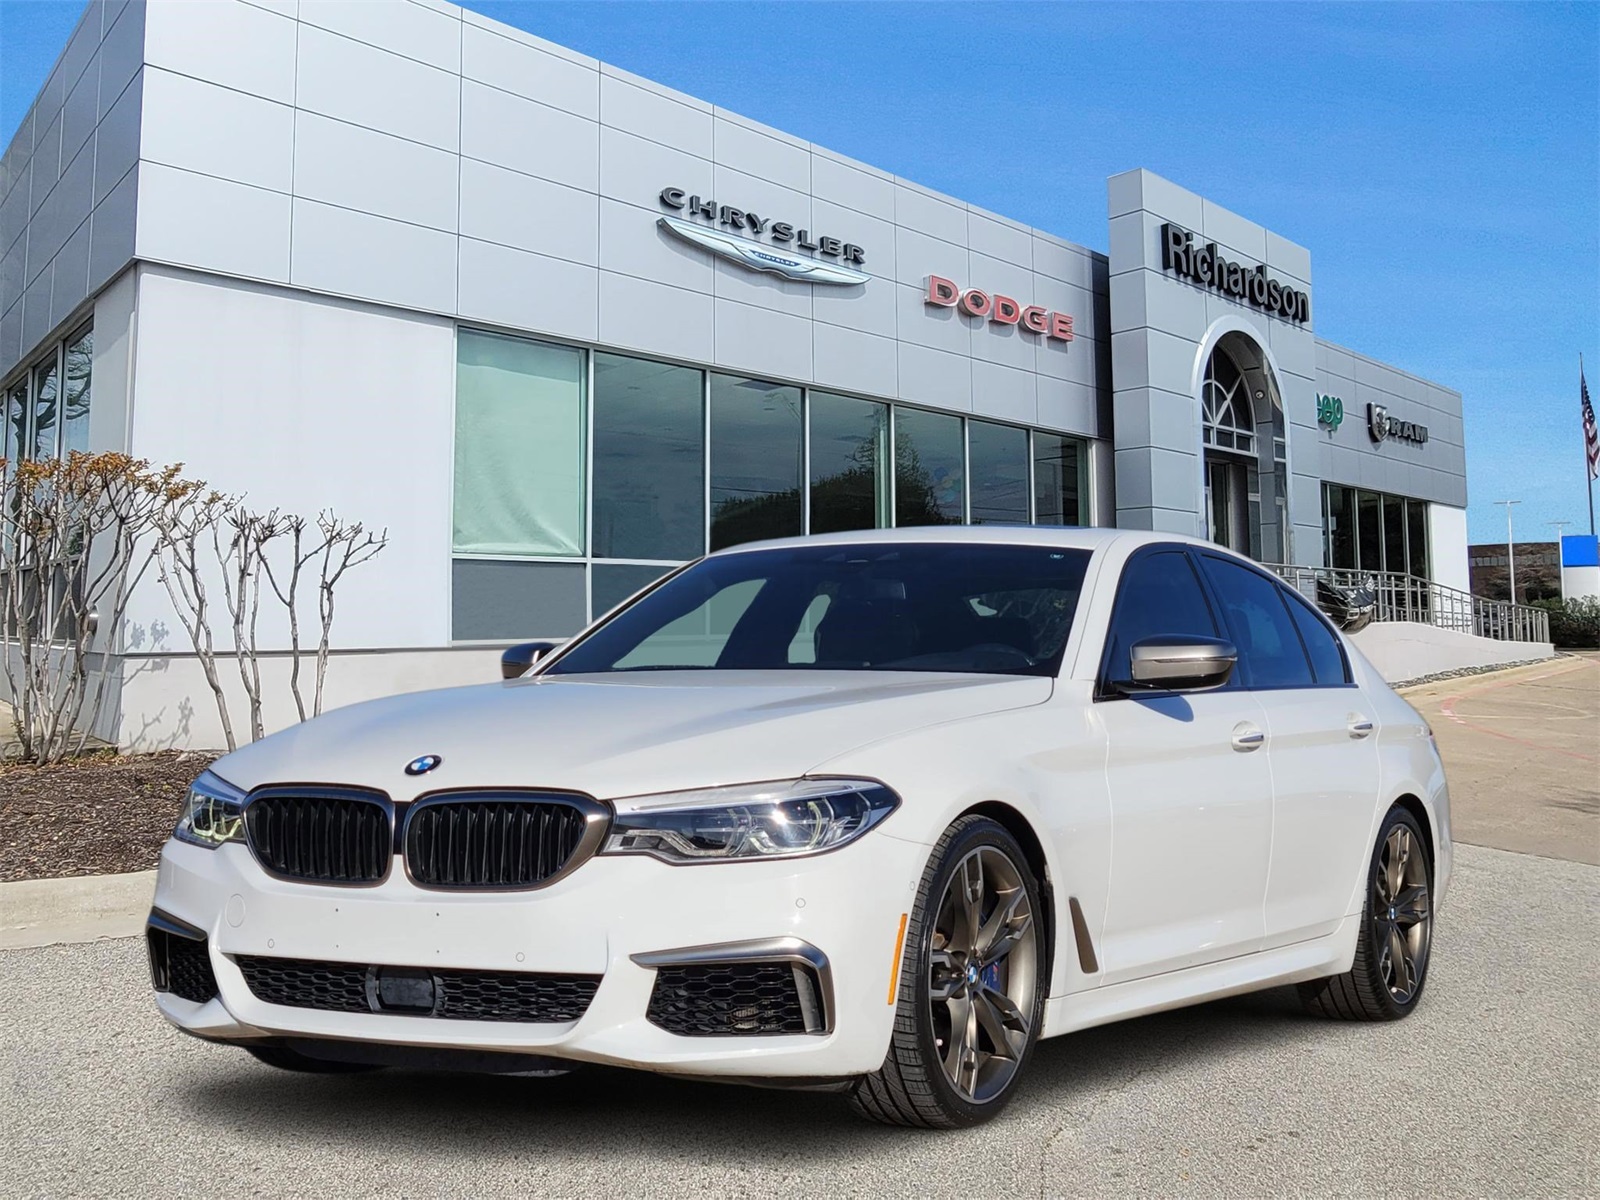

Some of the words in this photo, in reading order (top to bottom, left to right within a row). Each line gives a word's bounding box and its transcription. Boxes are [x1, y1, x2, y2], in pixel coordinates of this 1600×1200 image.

[659, 186, 866, 264] CHRYSLER
[923, 274, 1074, 342] DODGE
[1161, 223, 1309, 323] Richardson
[1386, 416, 1428, 443] RAM
